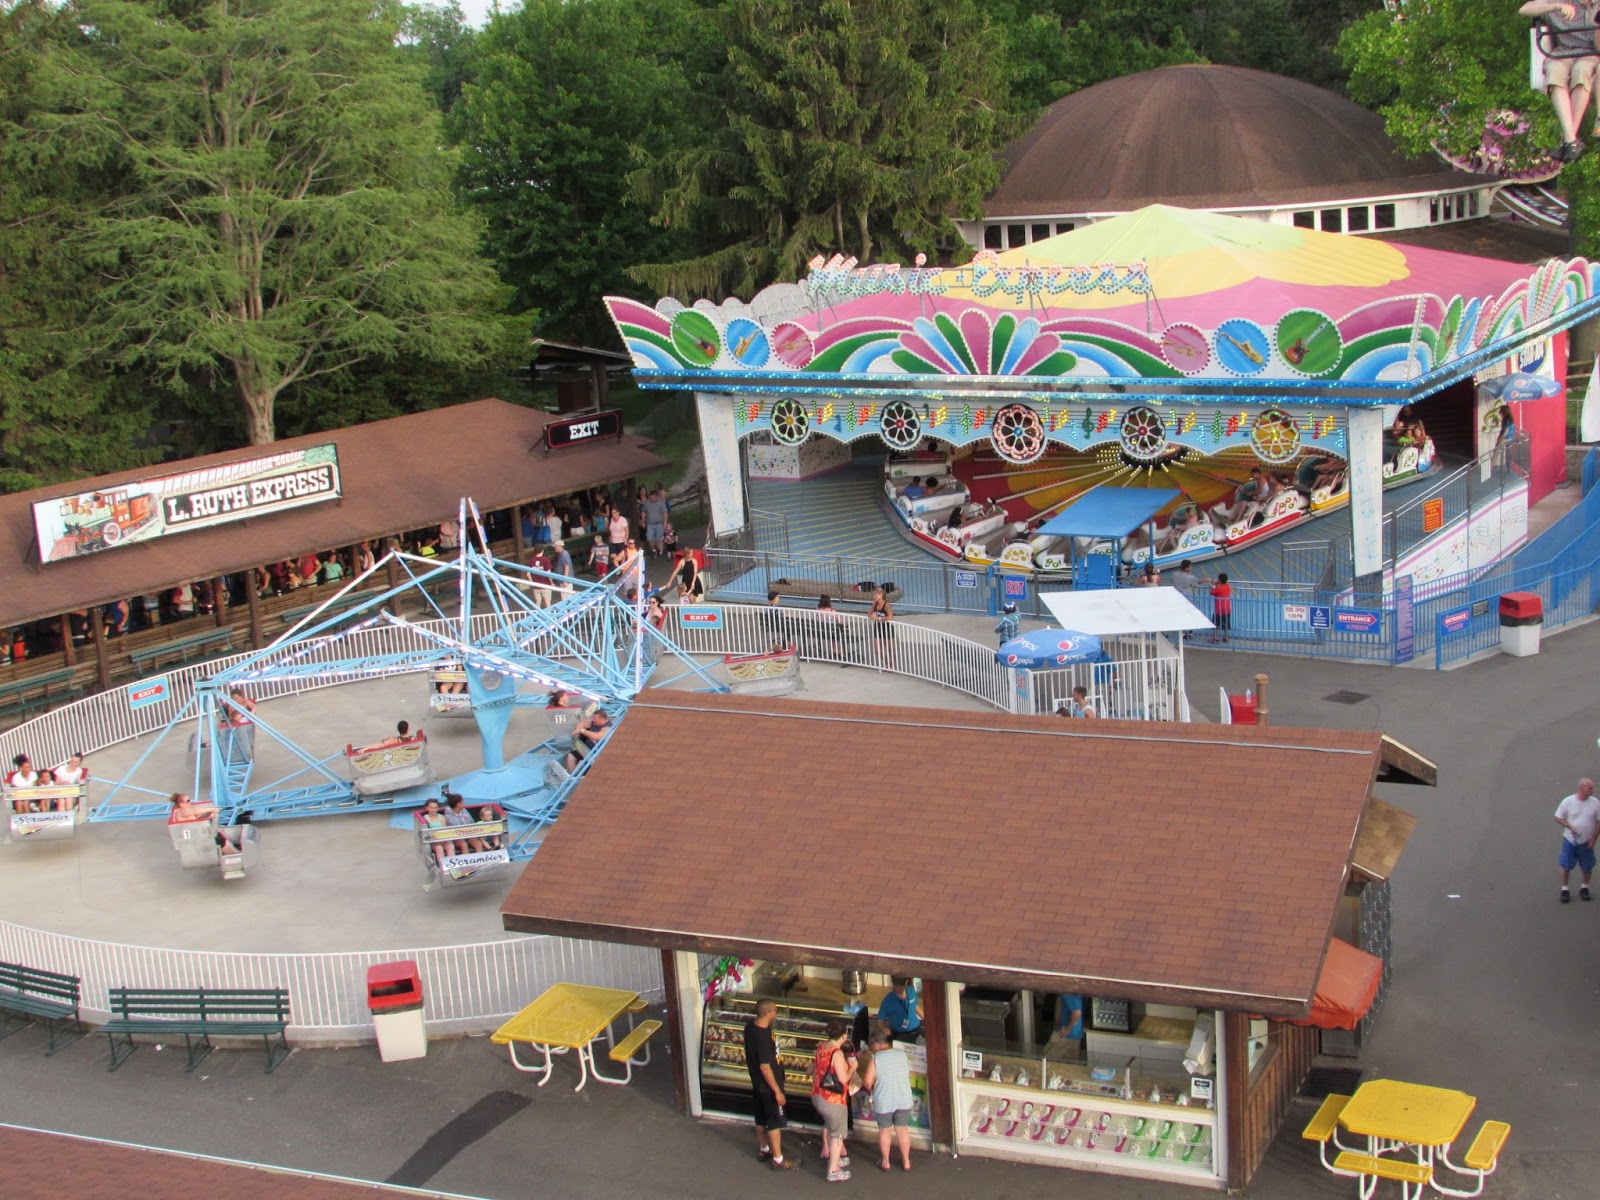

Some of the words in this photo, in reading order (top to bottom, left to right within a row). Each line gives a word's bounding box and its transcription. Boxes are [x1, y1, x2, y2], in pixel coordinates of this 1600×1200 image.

[569, 420, 599, 440] EXIT
[167, 497, 189, 522] L.
[190, 484, 249, 518] RUTH
[249, 467, 331, 503] EXPRESS
[1006, 580, 1024, 595] EXIT
[1338, 615, 1371, 623] ENTRANCE
[1445, 613, 1466, 624] ENTRANCE
[1017, 657, 1034, 666] pepsi
[555, 715, 566, 723] 12
[14, 814, 70, 824] Scrambler
[446, 853, 505, 868] Scrambler
